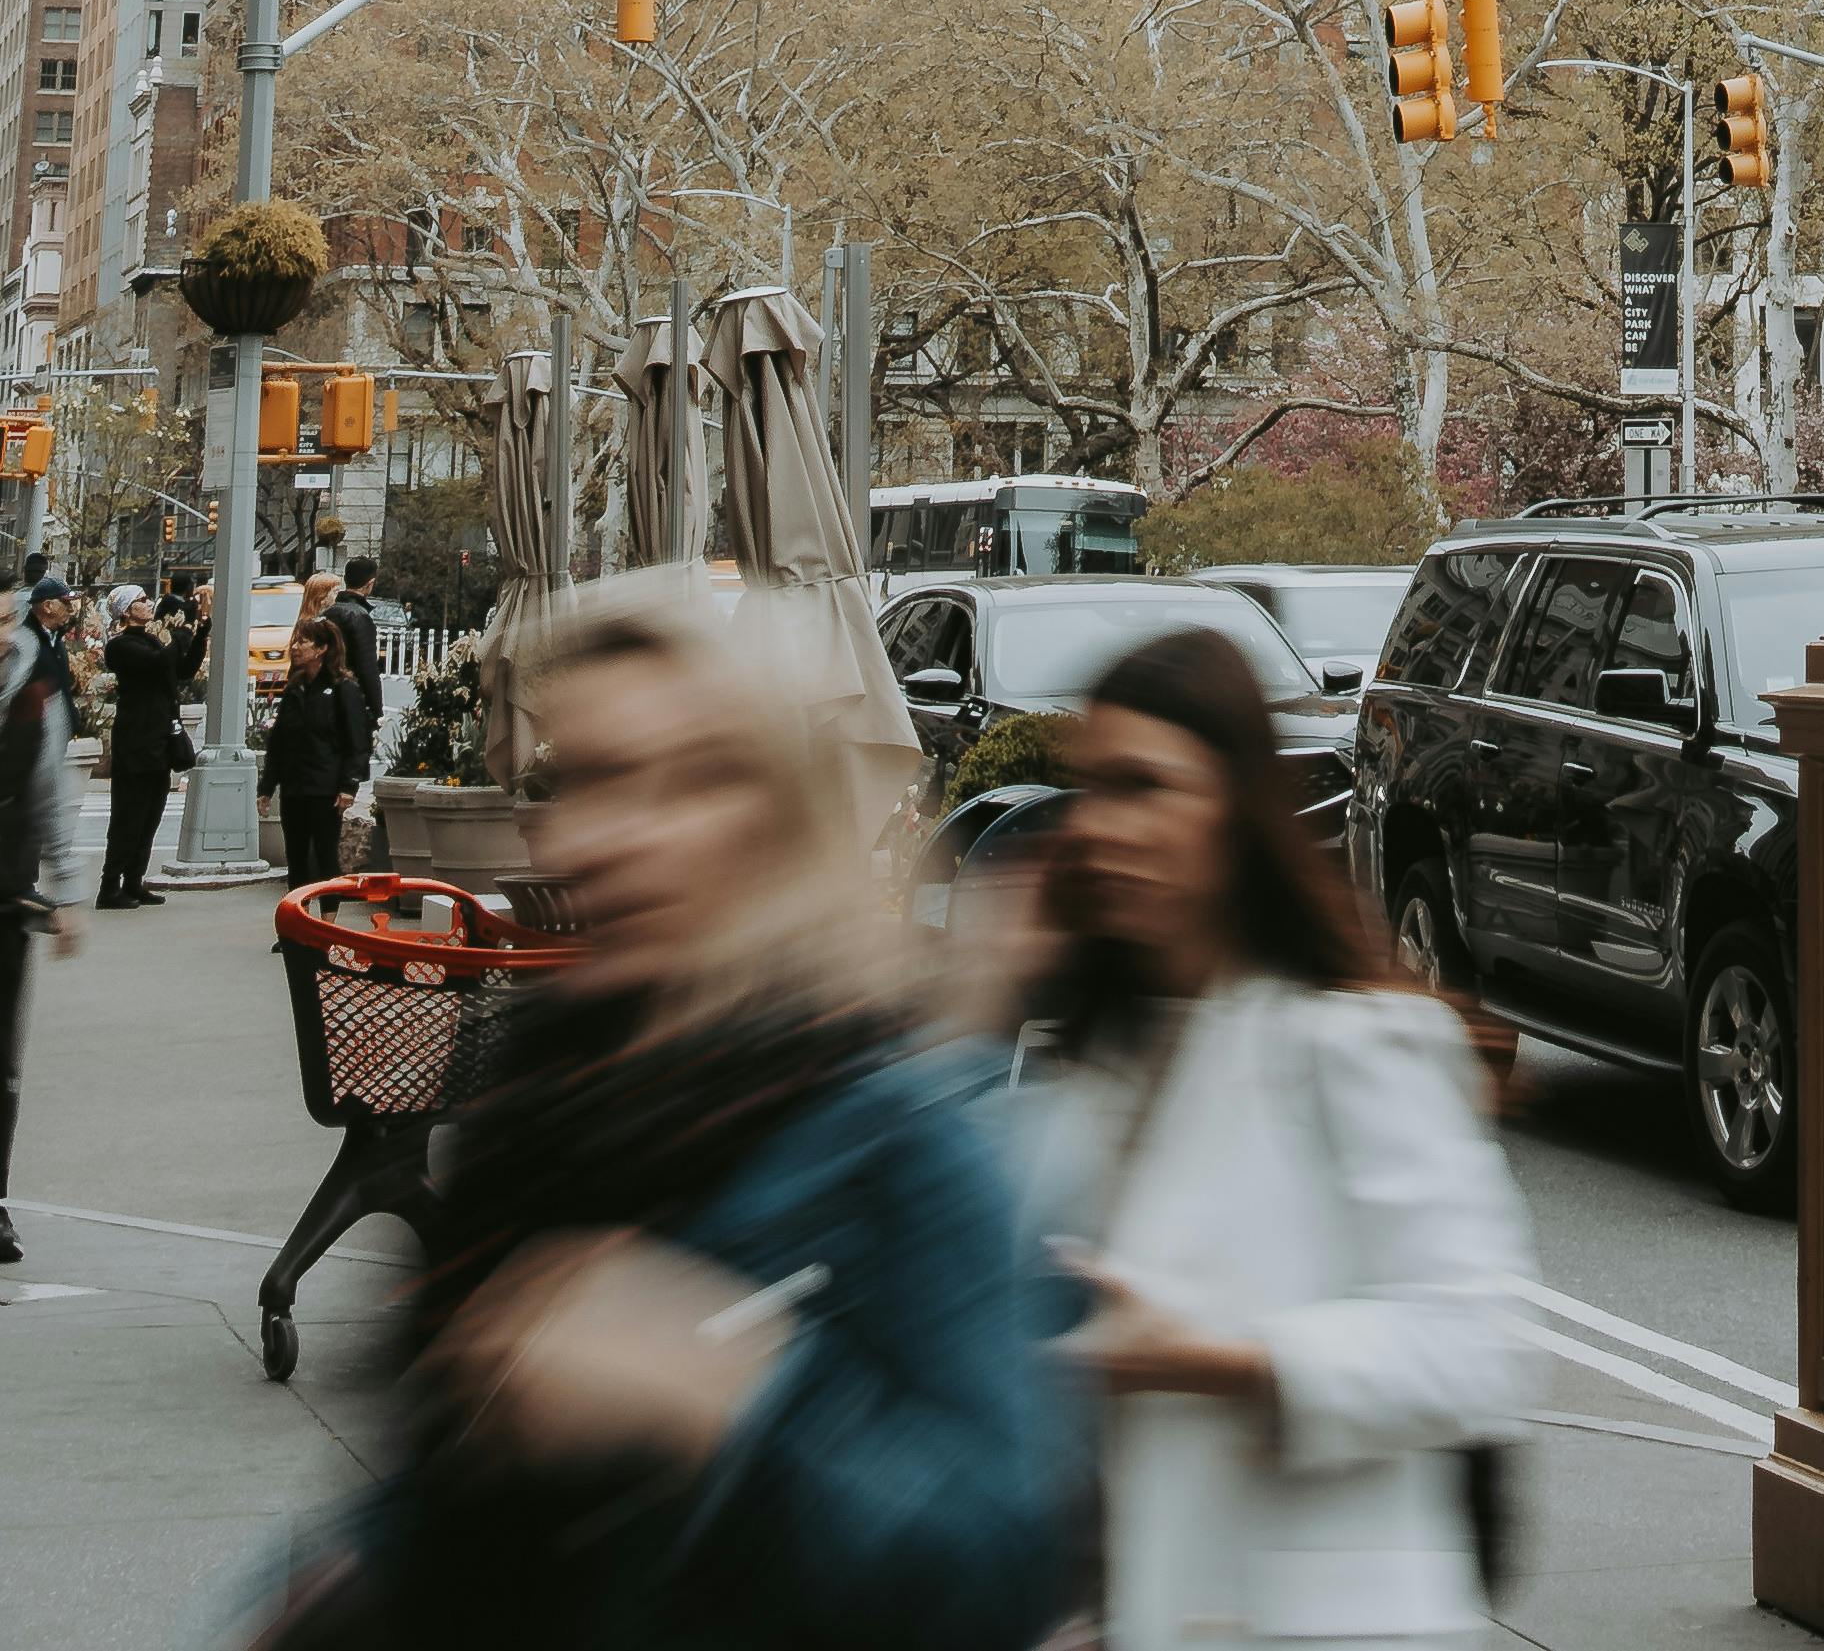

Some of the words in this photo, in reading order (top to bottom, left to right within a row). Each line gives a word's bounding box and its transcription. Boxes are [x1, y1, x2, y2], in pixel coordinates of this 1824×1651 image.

[1623, 273, 1675, 283] DISCOVER
[1624, 284, 1655, 294] WHAT
[1625, 296, 1632, 305] A
[1625, 308, 1648, 317] CITY
[1625, 320, 1651, 329] PARK
[1625, 331, 1647, 340] CAN
[1628, 428, 1645, 439] ONE
[1650, 428, 1666, 439] WAY
